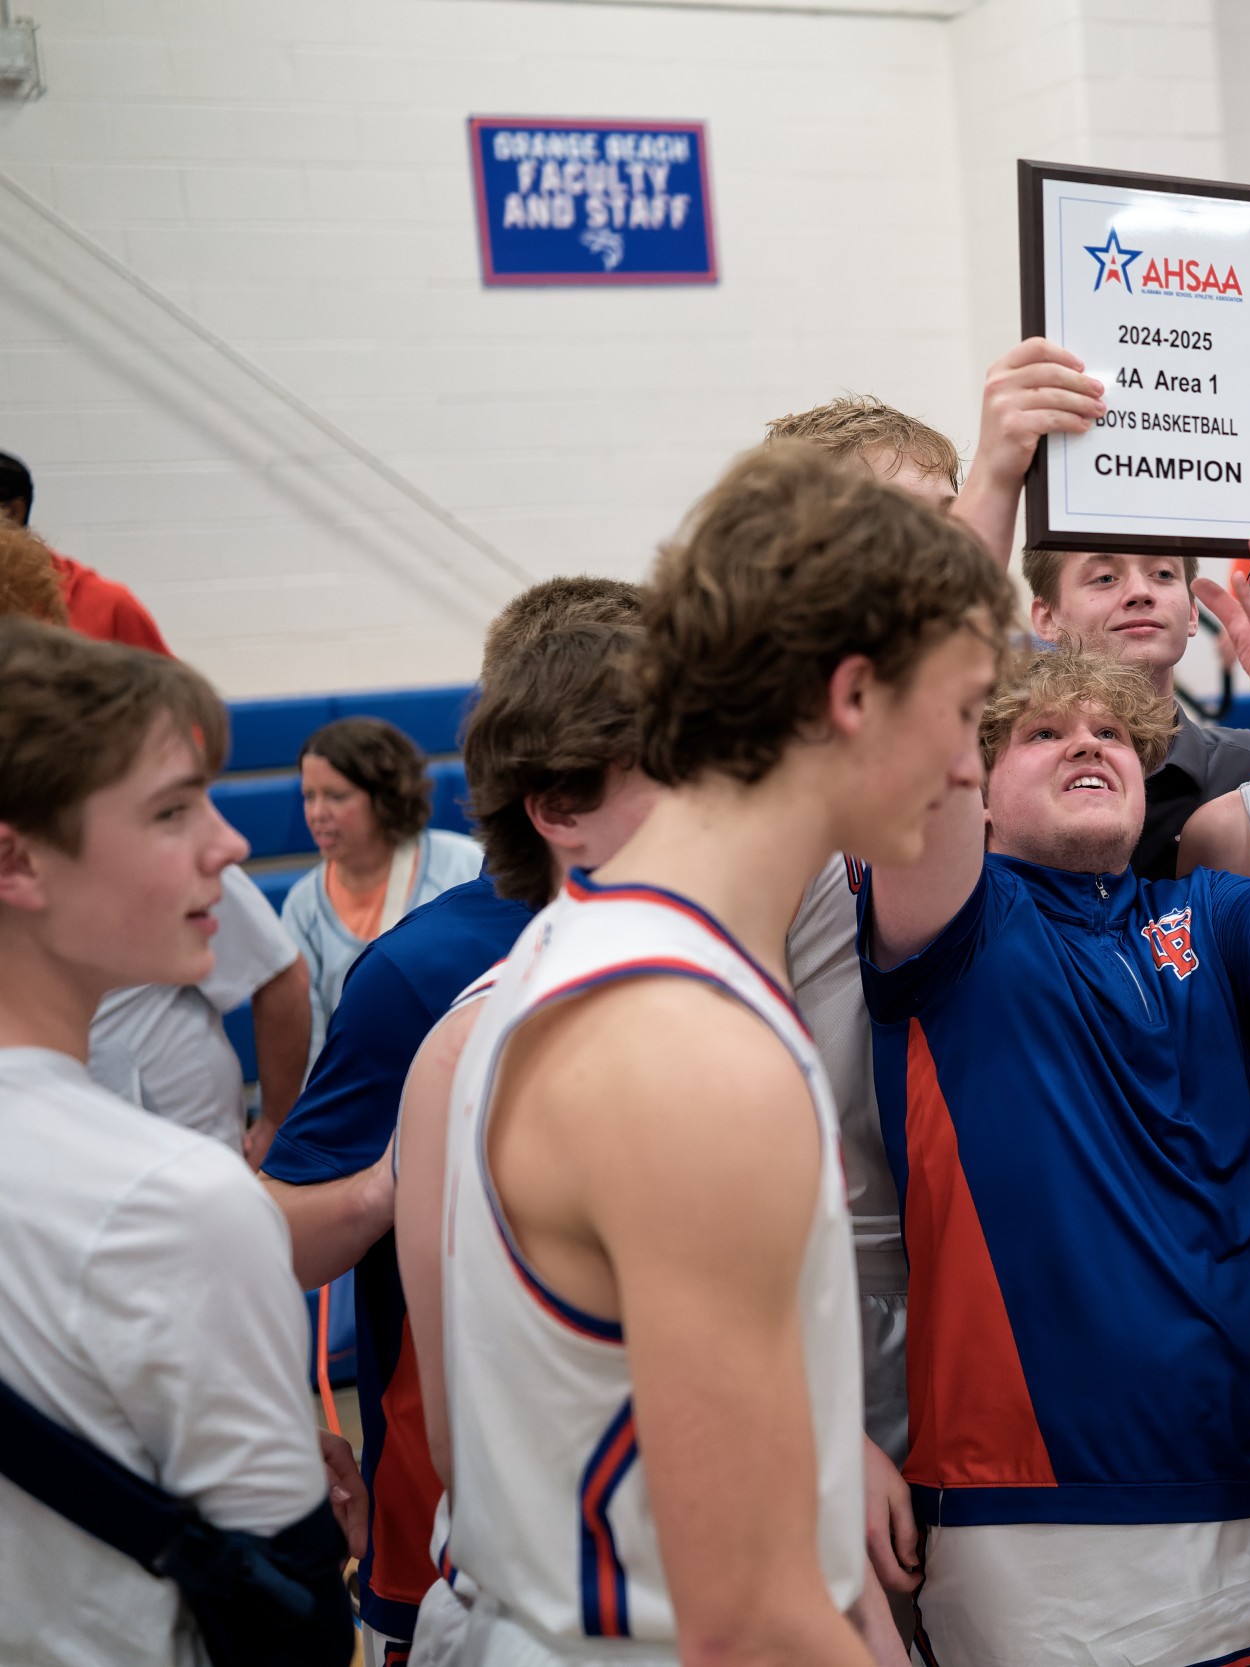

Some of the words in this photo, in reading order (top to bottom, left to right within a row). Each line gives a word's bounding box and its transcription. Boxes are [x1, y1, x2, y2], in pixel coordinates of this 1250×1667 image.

[493, 131, 599, 162] ORANGE
[605, 133, 690, 164] BEACH
[517, 159, 670, 196] FACULTY
[503, 192, 576, 229] AND
[585, 193, 691, 230] STAFF
[1142, 257, 1243, 296] AHSAA
[1118, 325, 1213, 351] 2024-2025
[1116, 366, 1144, 389] 4A
[1154, 370, 1202, 393] Area
[1209, 374, 1218, 394] 1
[1141, 412, 1239, 436] BASKETBALL
[1094, 453, 1242, 484] CHAMPION
